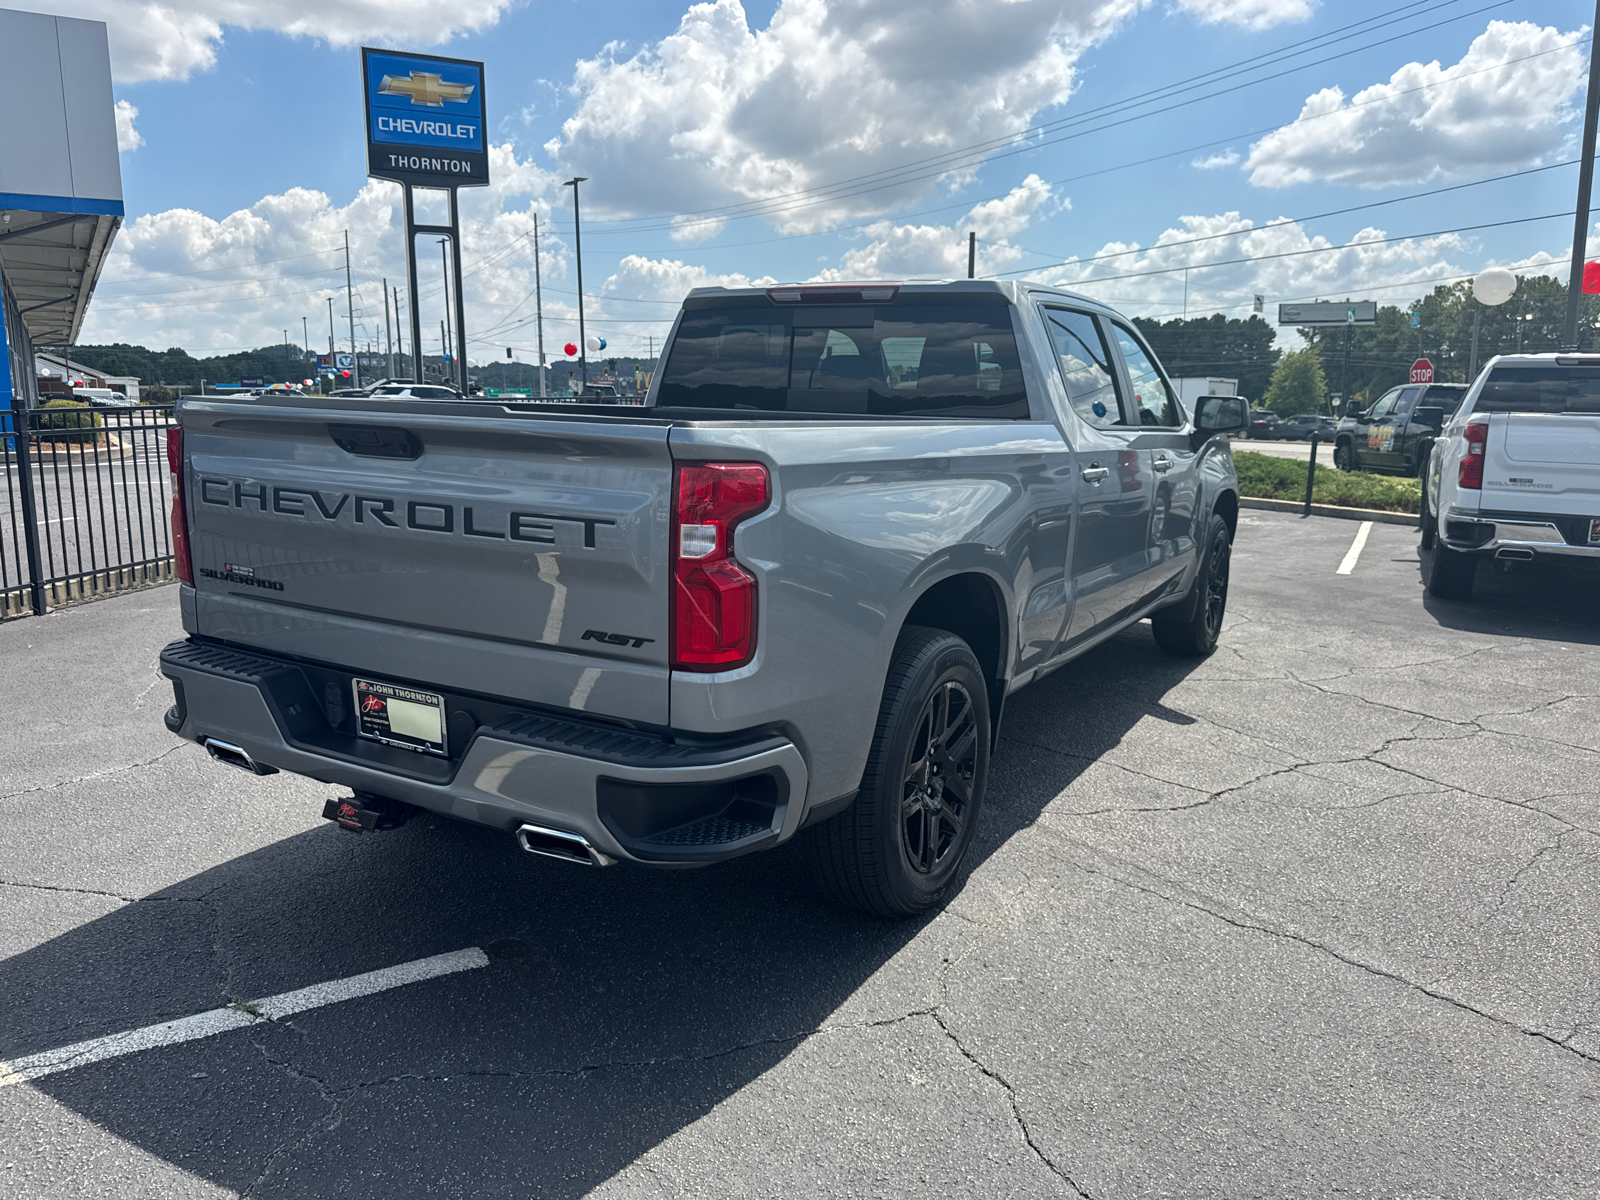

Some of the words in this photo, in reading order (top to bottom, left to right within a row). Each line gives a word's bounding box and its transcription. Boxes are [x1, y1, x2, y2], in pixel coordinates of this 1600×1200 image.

[378, 116, 476, 139] CHEVROLET
[389, 154, 471, 173] THORNTON
[1411, 368, 1432, 382] STOP
[1486, 480, 1554, 489] SILVERADO
[200, 479, 617, 549] CHEVROLET
[199, 567, 284, 591] SILVERADO
[580, 629, 655, 649] RST
[373, 684, 394, 695] JOHN
[395, 689, 438, 705] THORNTON
[389, 741, 415, 751] CHEVROLET
